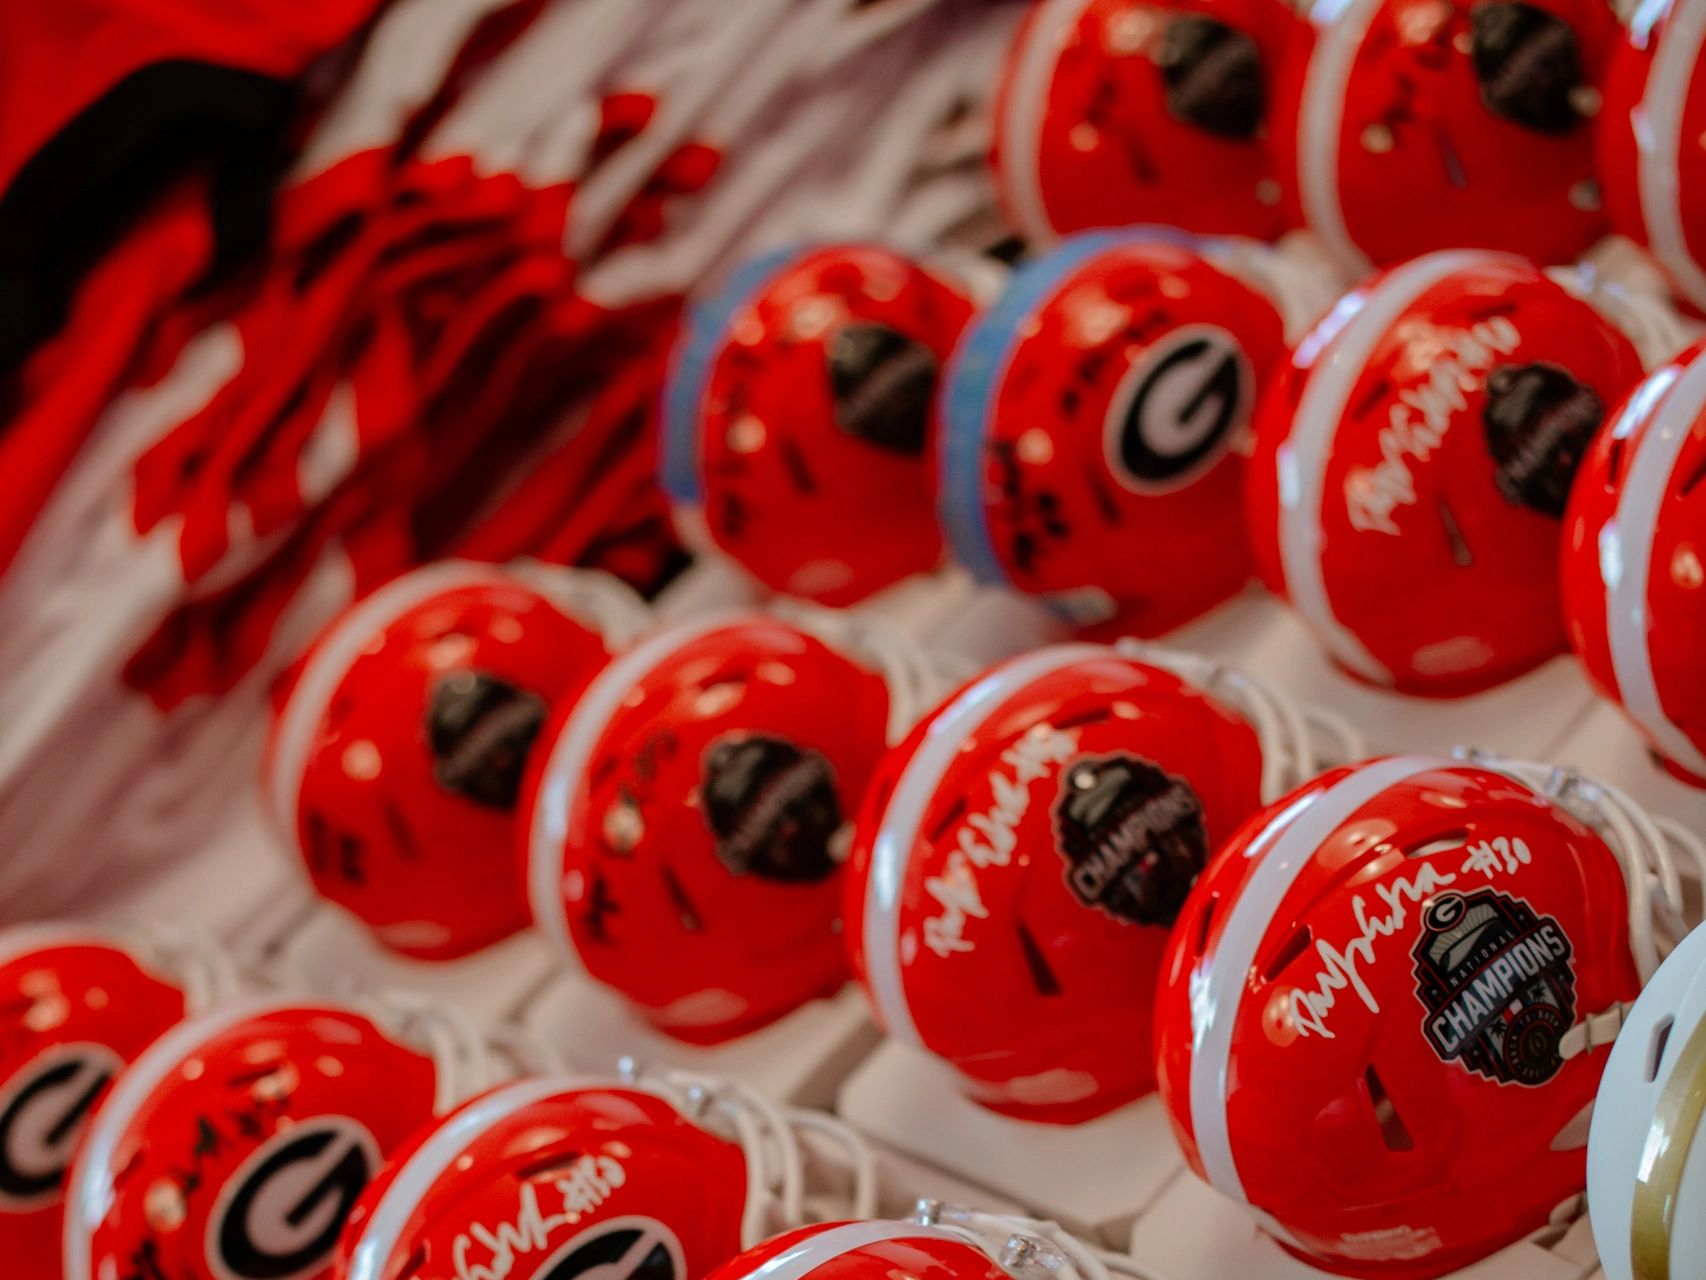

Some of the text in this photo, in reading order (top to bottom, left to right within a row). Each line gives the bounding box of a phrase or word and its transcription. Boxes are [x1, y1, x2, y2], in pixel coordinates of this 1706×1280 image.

[1460, 836, 1533, 880] #30
[1432, 924, 1565, 1052] CHAMPIONS
[1449, 929, 1514, 988] NATIONAL
